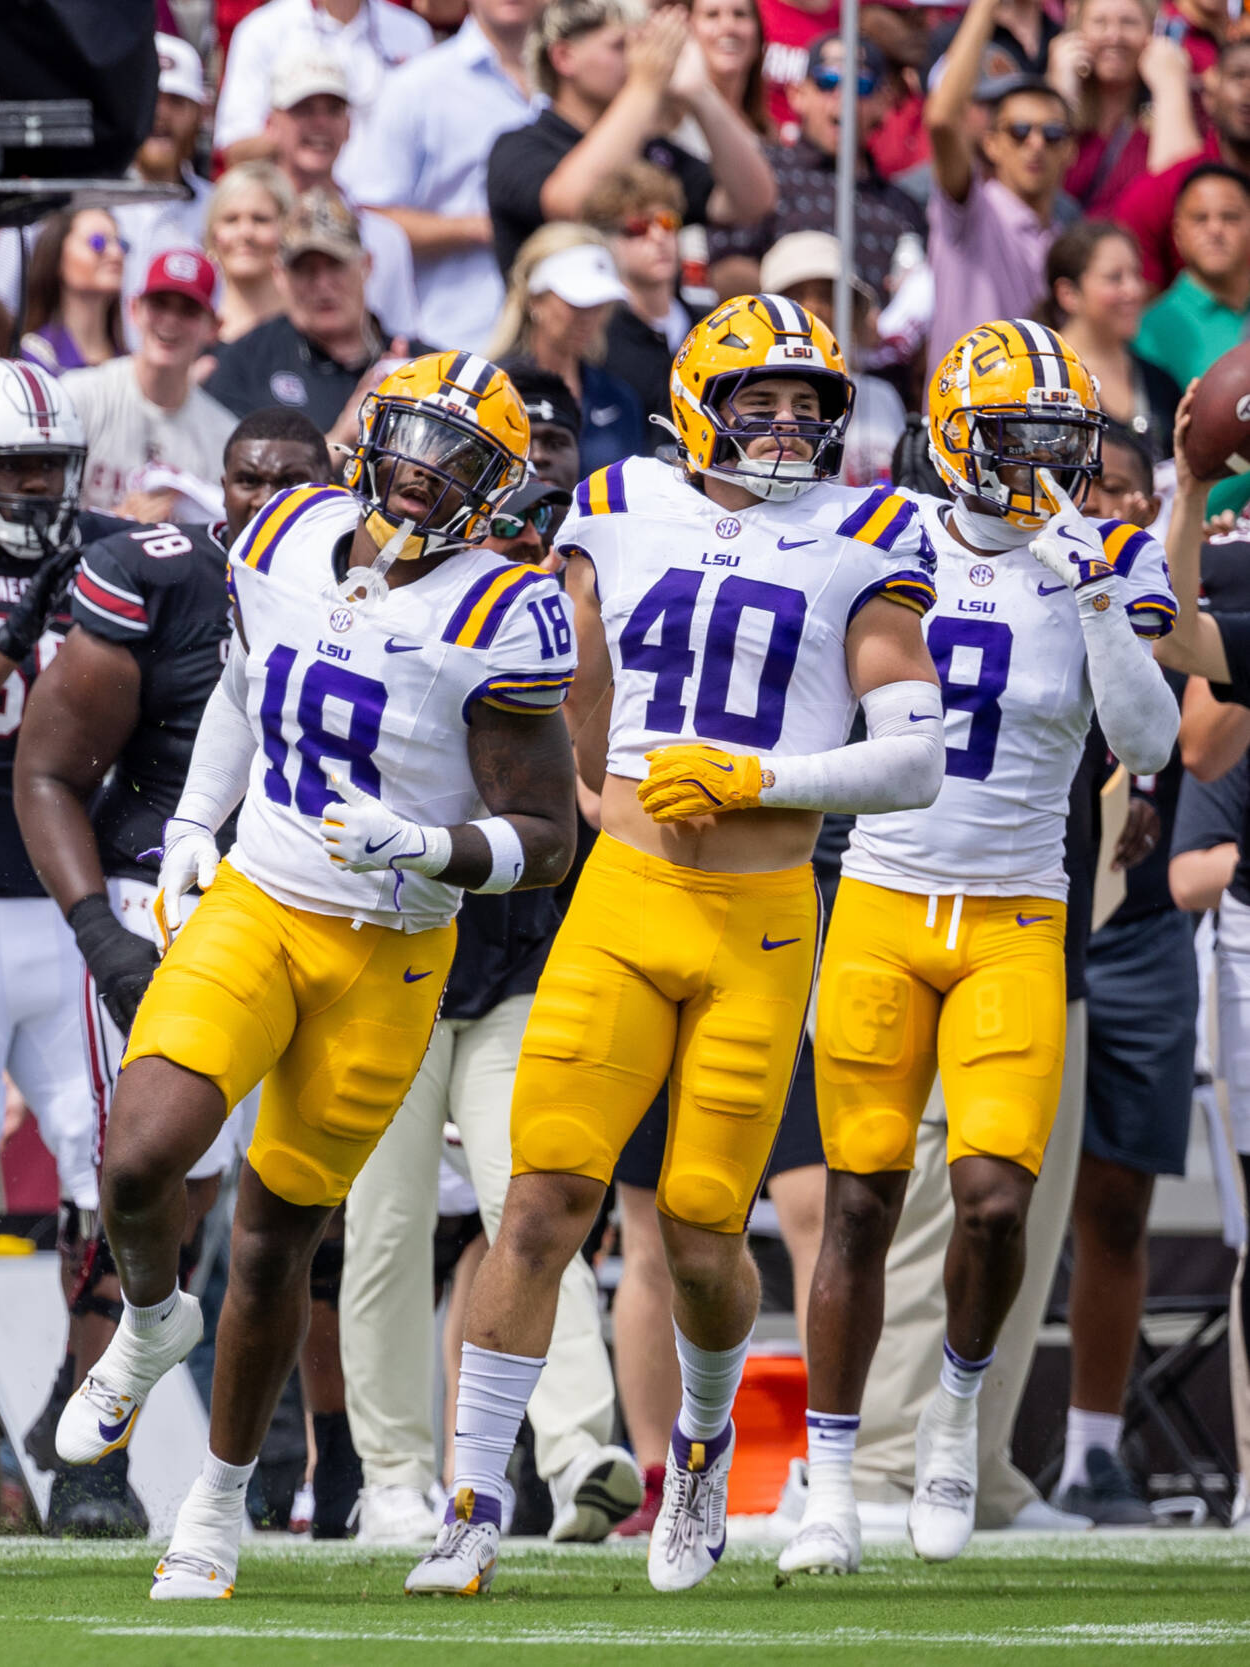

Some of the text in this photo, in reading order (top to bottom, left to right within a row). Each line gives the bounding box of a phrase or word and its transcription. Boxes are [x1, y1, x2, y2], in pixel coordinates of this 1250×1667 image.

[783, 347, 814, 359] LSU
[1041, 391, 1069, 403] LSU
[717, 518, 740, 538] SEC
[701, 552, 741, 568] LSU
[970, 564, 994, 587] SEC
[957, 599, 996, 614] LSU
[329, 607, 354, 633] SEC
[526, 594, 572, 661] 18
[317, 639, 352, 662] LSU
[619, 567, 808, 751] 40
[927, 615, 1014, 782] 8
[260, 643, 389, 818] 18
